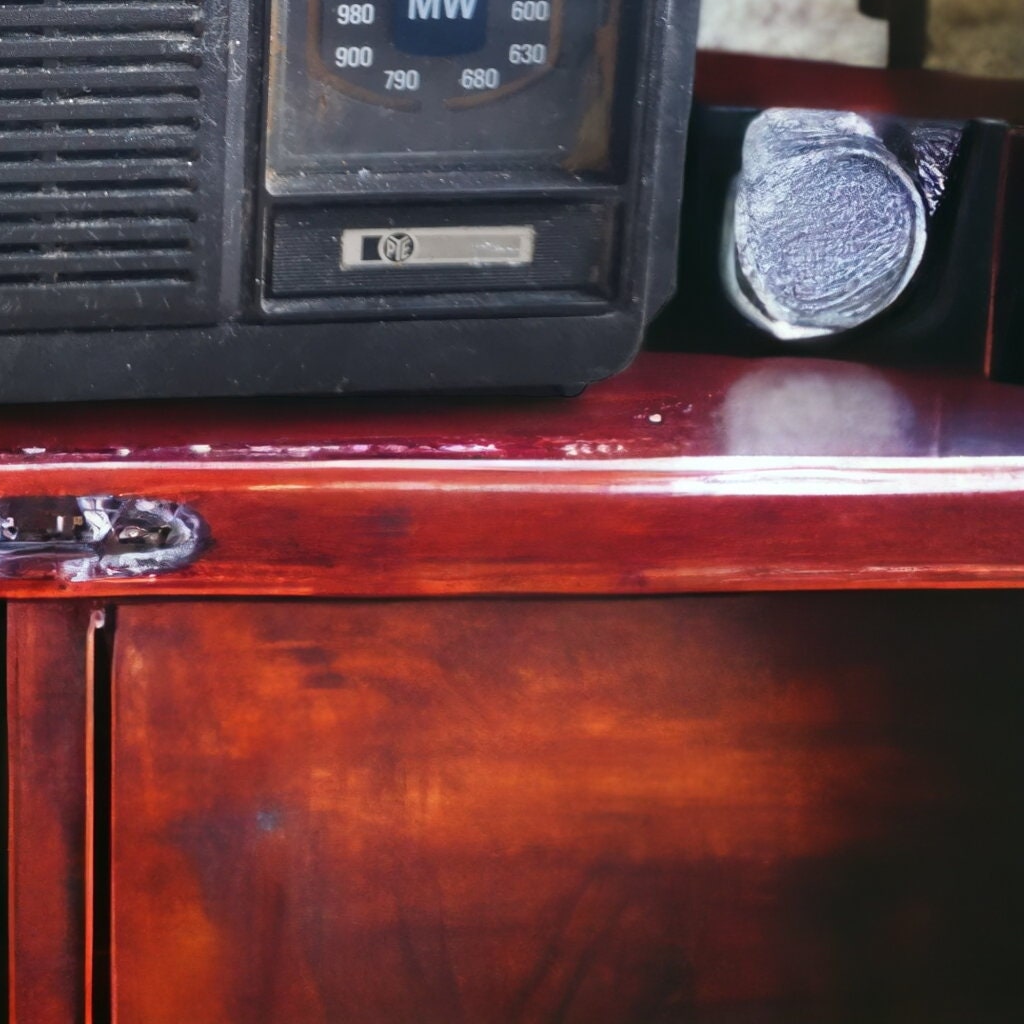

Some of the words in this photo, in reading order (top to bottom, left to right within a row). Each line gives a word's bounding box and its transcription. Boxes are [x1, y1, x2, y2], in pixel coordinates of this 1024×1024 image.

[338, 4, 374, 24] 980
[512, 1, 550, 21] 600
[336, 47, 372, 67] 900
[509, 44, 546, 63] 630
[385, 70, 420, 90] 790
[461, 69, 499, 88] 680
